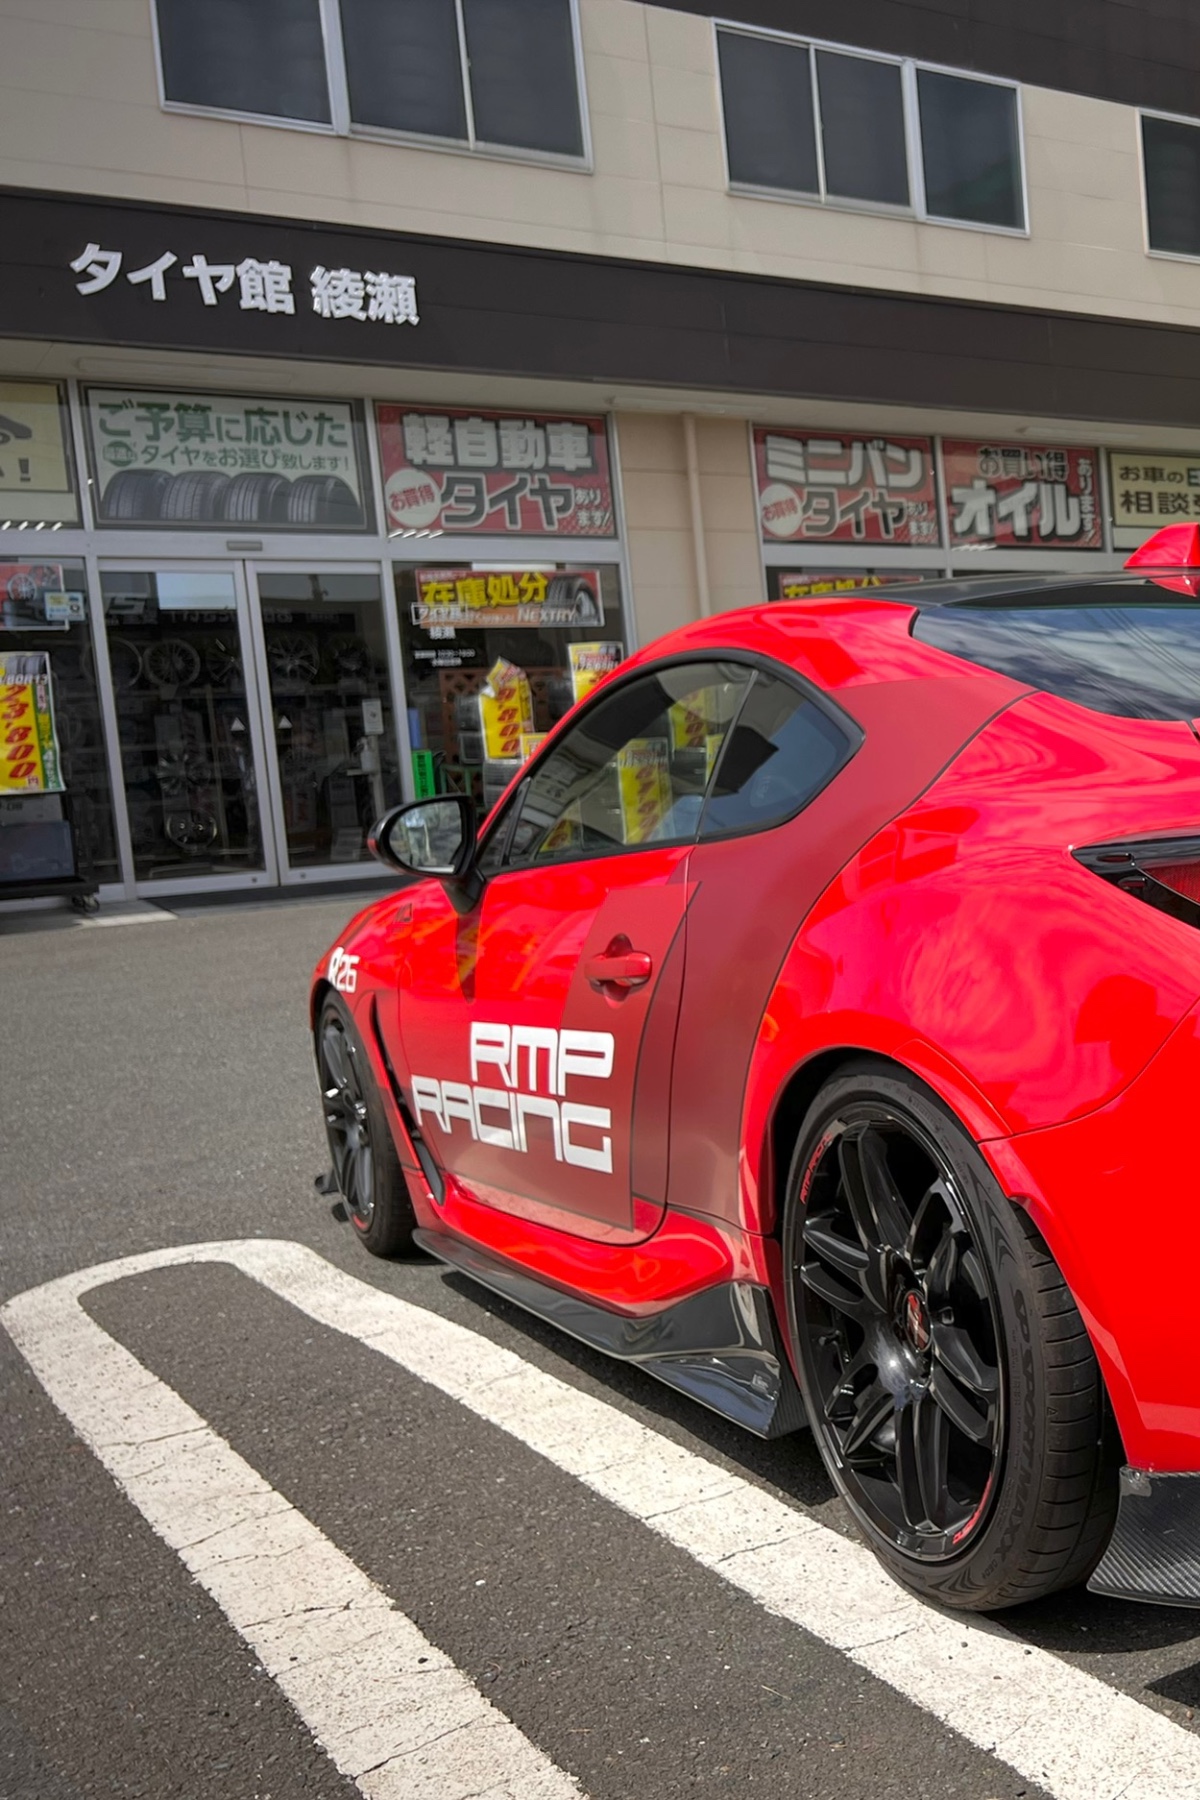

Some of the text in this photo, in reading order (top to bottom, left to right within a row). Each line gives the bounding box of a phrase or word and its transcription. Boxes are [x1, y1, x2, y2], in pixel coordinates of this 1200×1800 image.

[69, 242, 421, 327] タイヤ館 綾瀬
[98, 398, 349, 449] ご予算に応じた
[402, 412, 593, 472] 軽自動車
[765, 434, 923, 489] ミニバン
[977, 446, 1070, 482] お買い得
[441, 473, 575, 531] タイヤ
[801, 487, 908, 540] タイヤ
[951, 478, 1083, 537] オイル
[421, 572, 550, 610] 在庫処分
[469, 1020, 615, 1097] RMP
[411, 1073, 613, 1175] RACING
